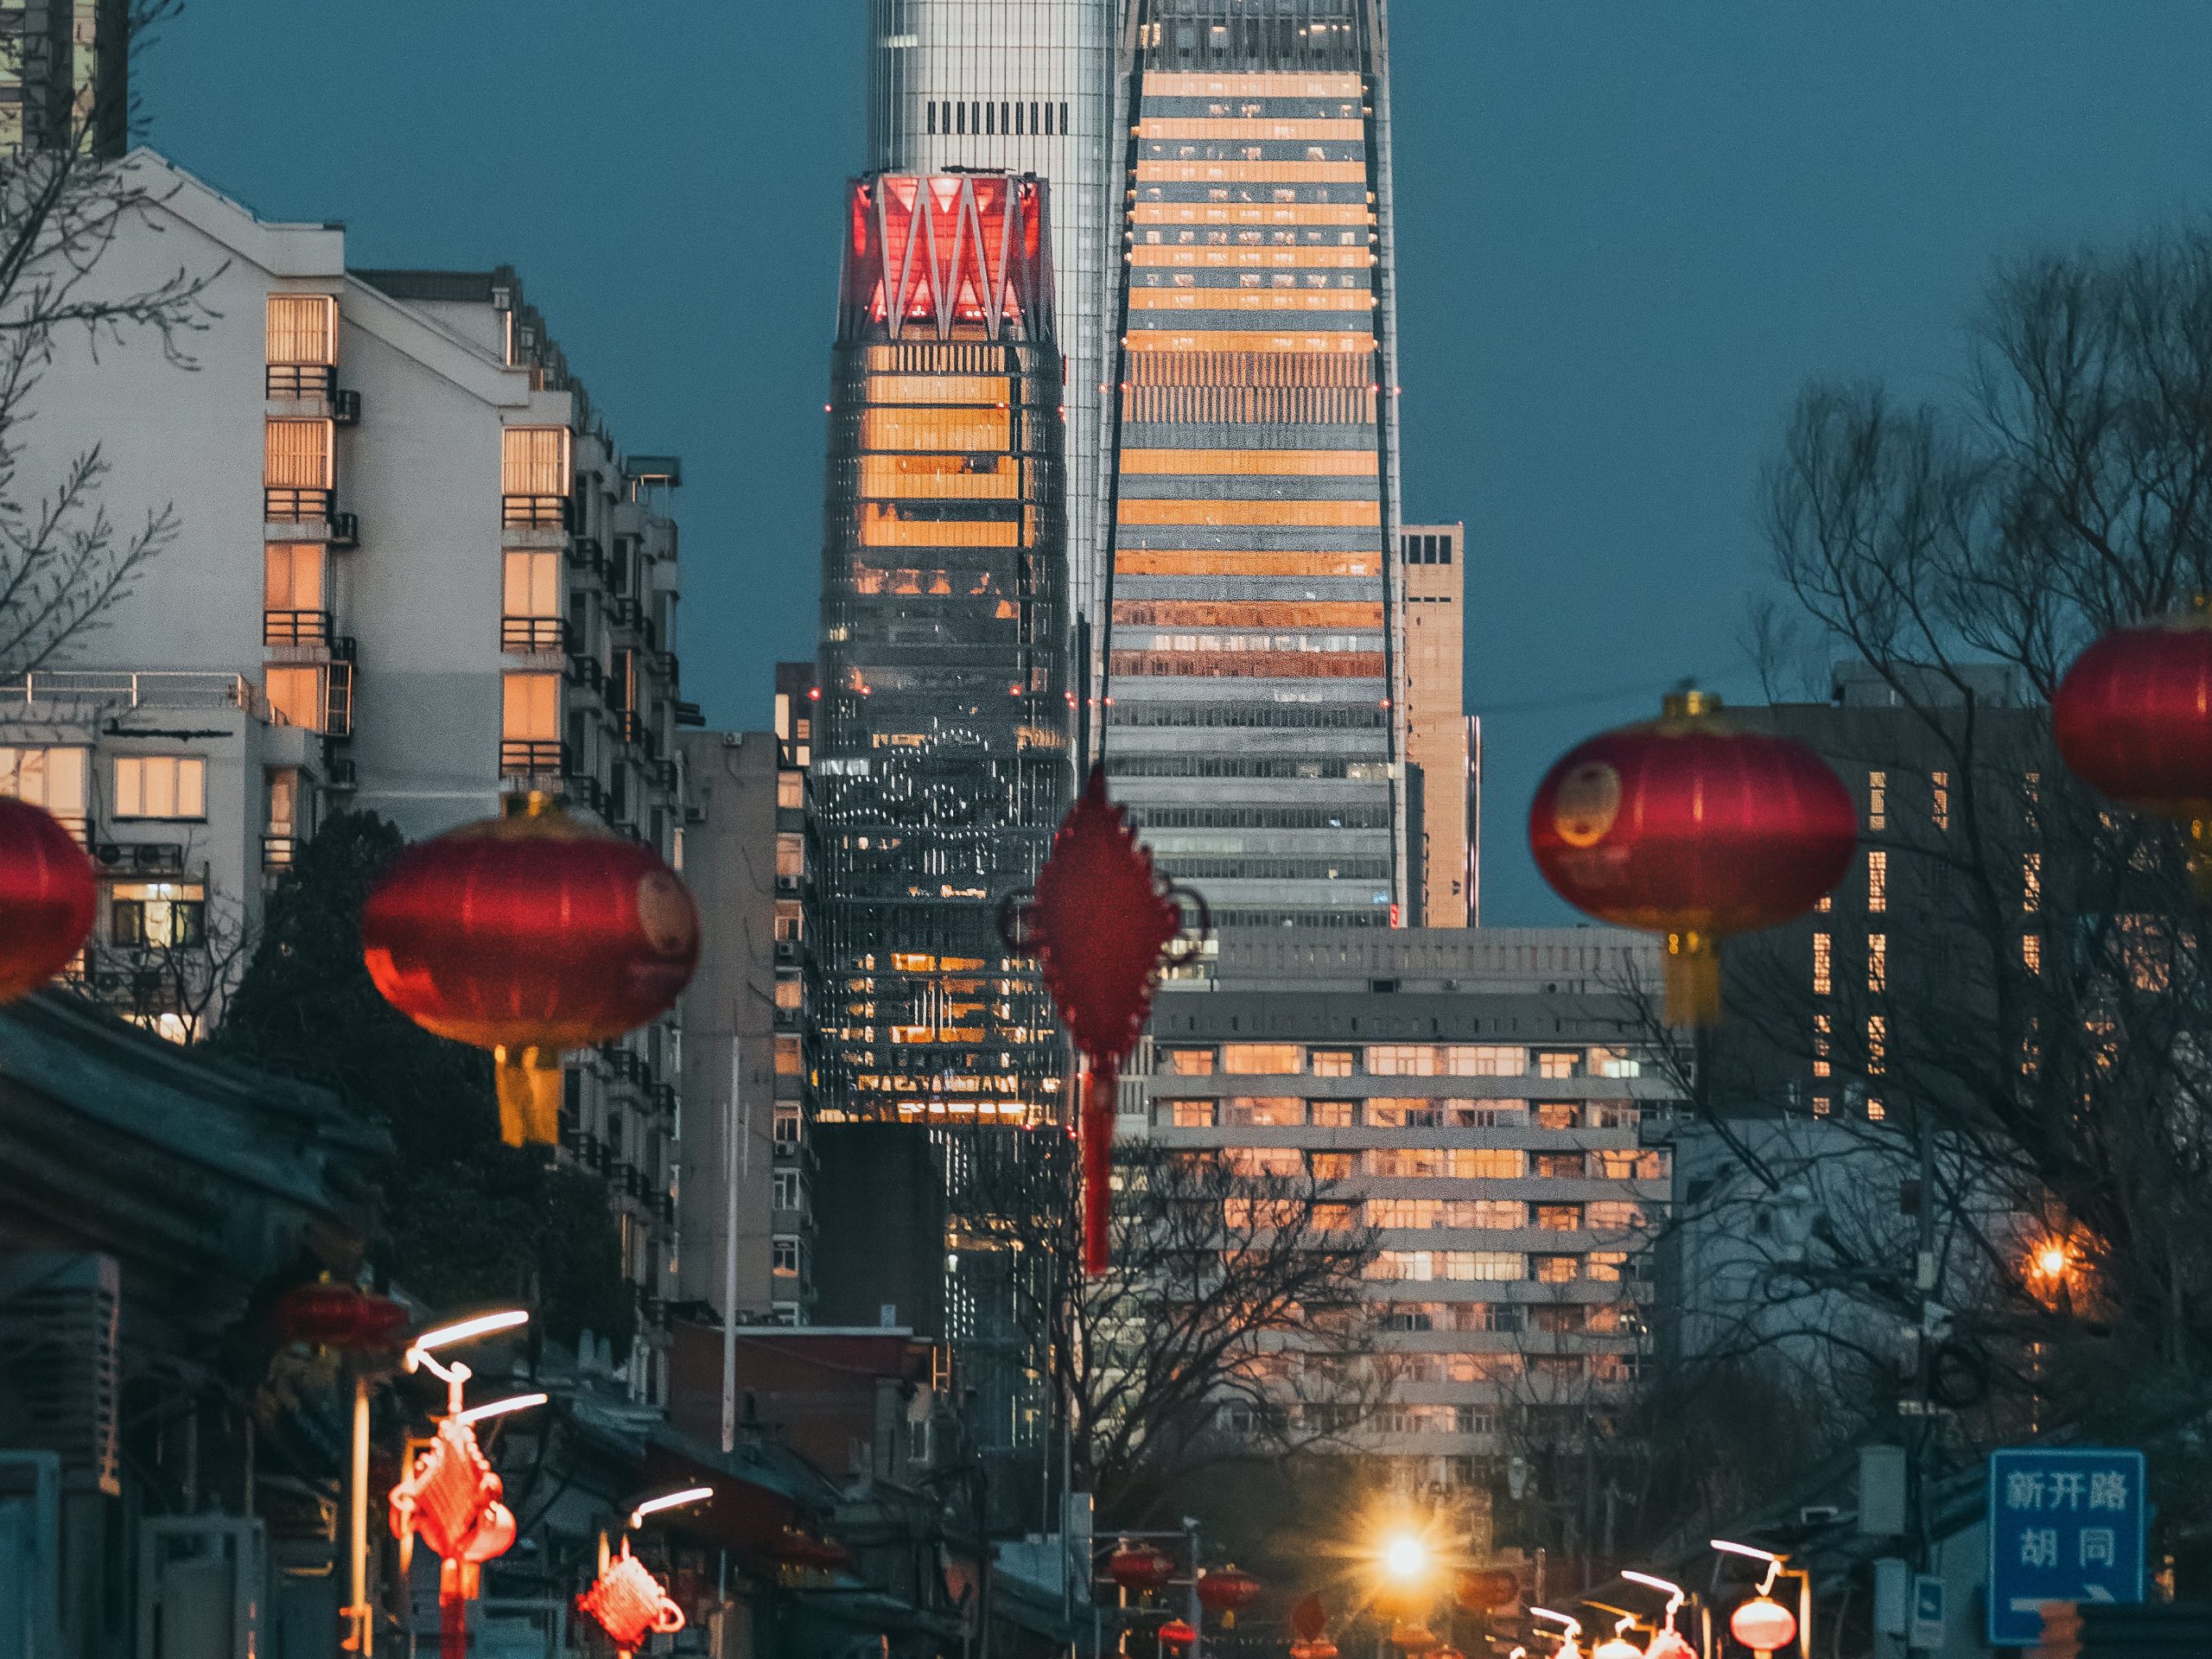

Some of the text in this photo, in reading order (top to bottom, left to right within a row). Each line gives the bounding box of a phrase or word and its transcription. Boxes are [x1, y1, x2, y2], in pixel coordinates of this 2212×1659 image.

[2006, 1471, 2127, 1510] 新开路
[2019, 1528, 2114, 1567] 胡同
